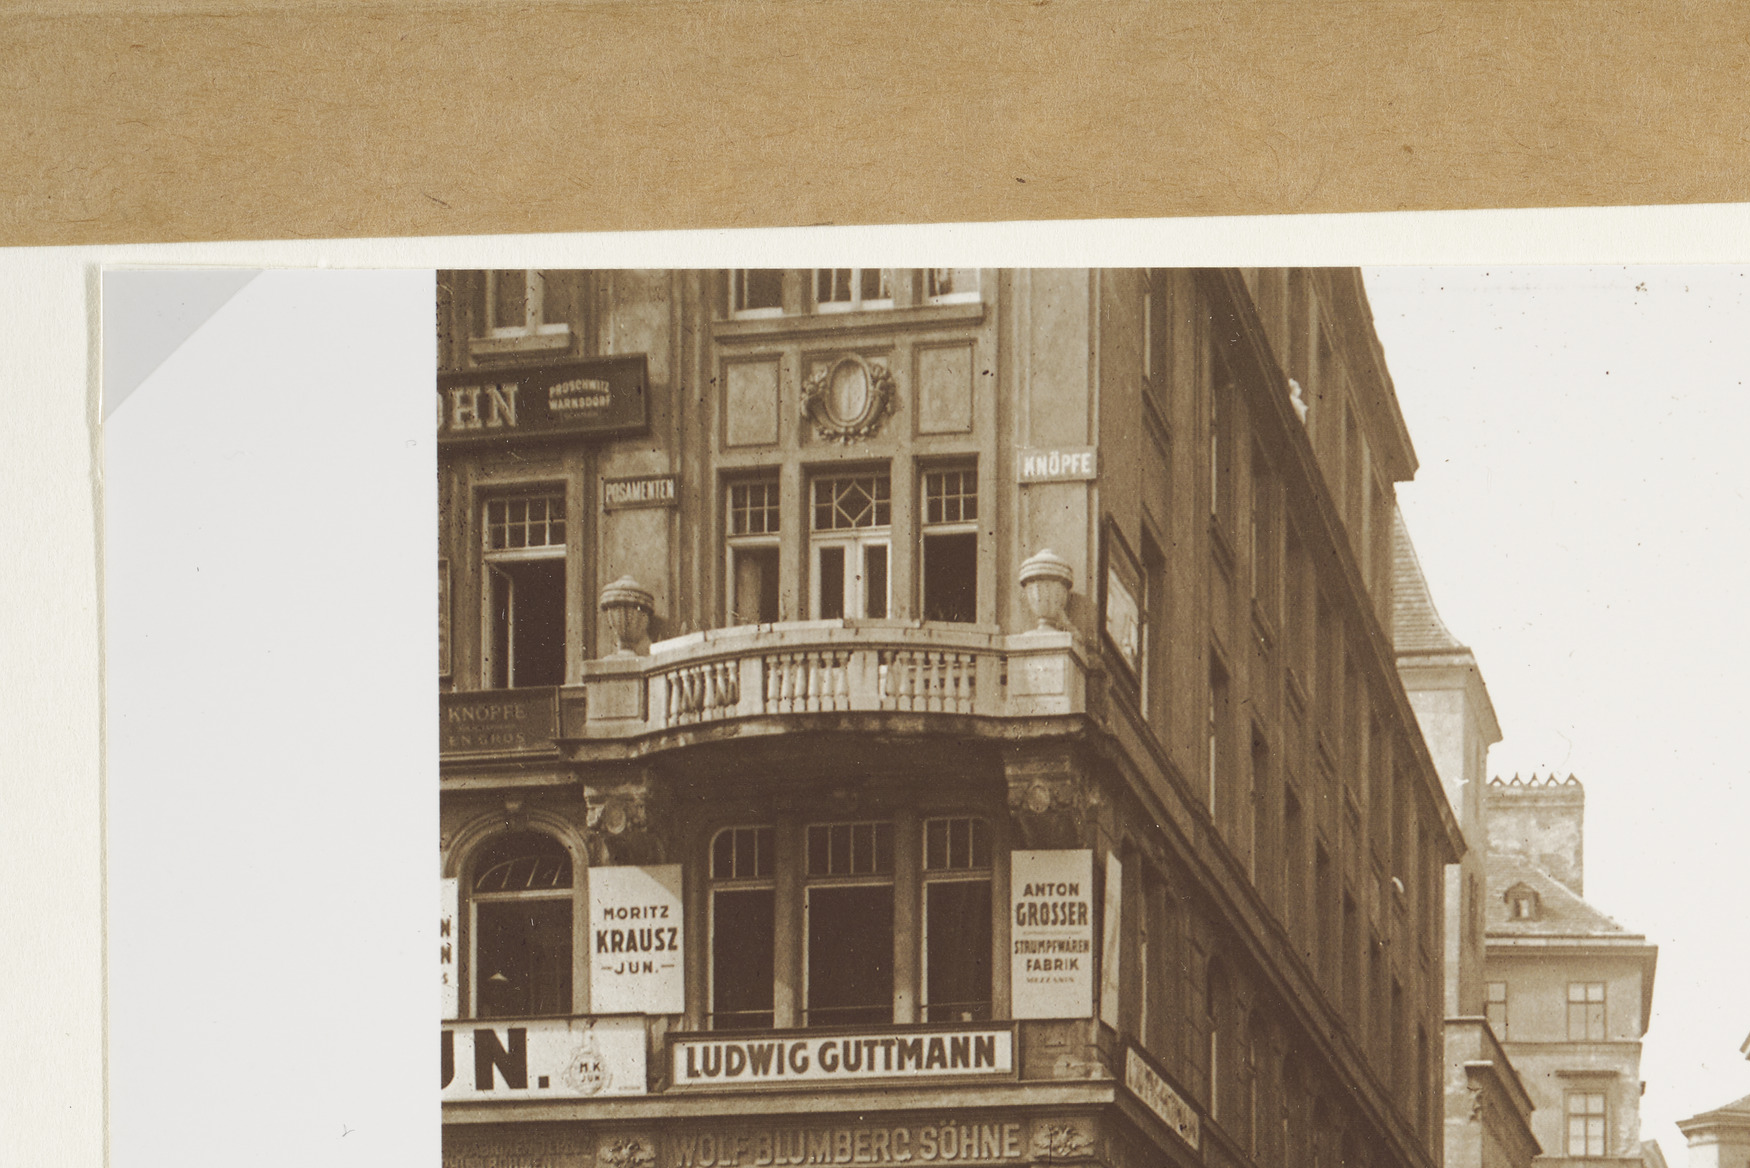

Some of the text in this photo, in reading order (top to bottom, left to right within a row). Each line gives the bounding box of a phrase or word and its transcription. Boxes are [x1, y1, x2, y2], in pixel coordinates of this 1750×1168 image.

[437, 385, 518, 431] HN
[1024, 452, 1092, 478] KNÖPFE
[605, 479, 675, 504] POSAMENTEN
[1023, 883, 1080, 897] ANTON
[604, 905, 669, 921] MORITZ
[1016, 902, 1088, 926] GROSSER
[596, 927, 679, 954] KRAUSZ
[1026, 958, 1080, 972] FABRIK
[686, 1035, 996, 1079] LUDWIG GUTTMANN
[675, 1119, 1021, 1168] WOLF BLUMBERG SÖHNE
